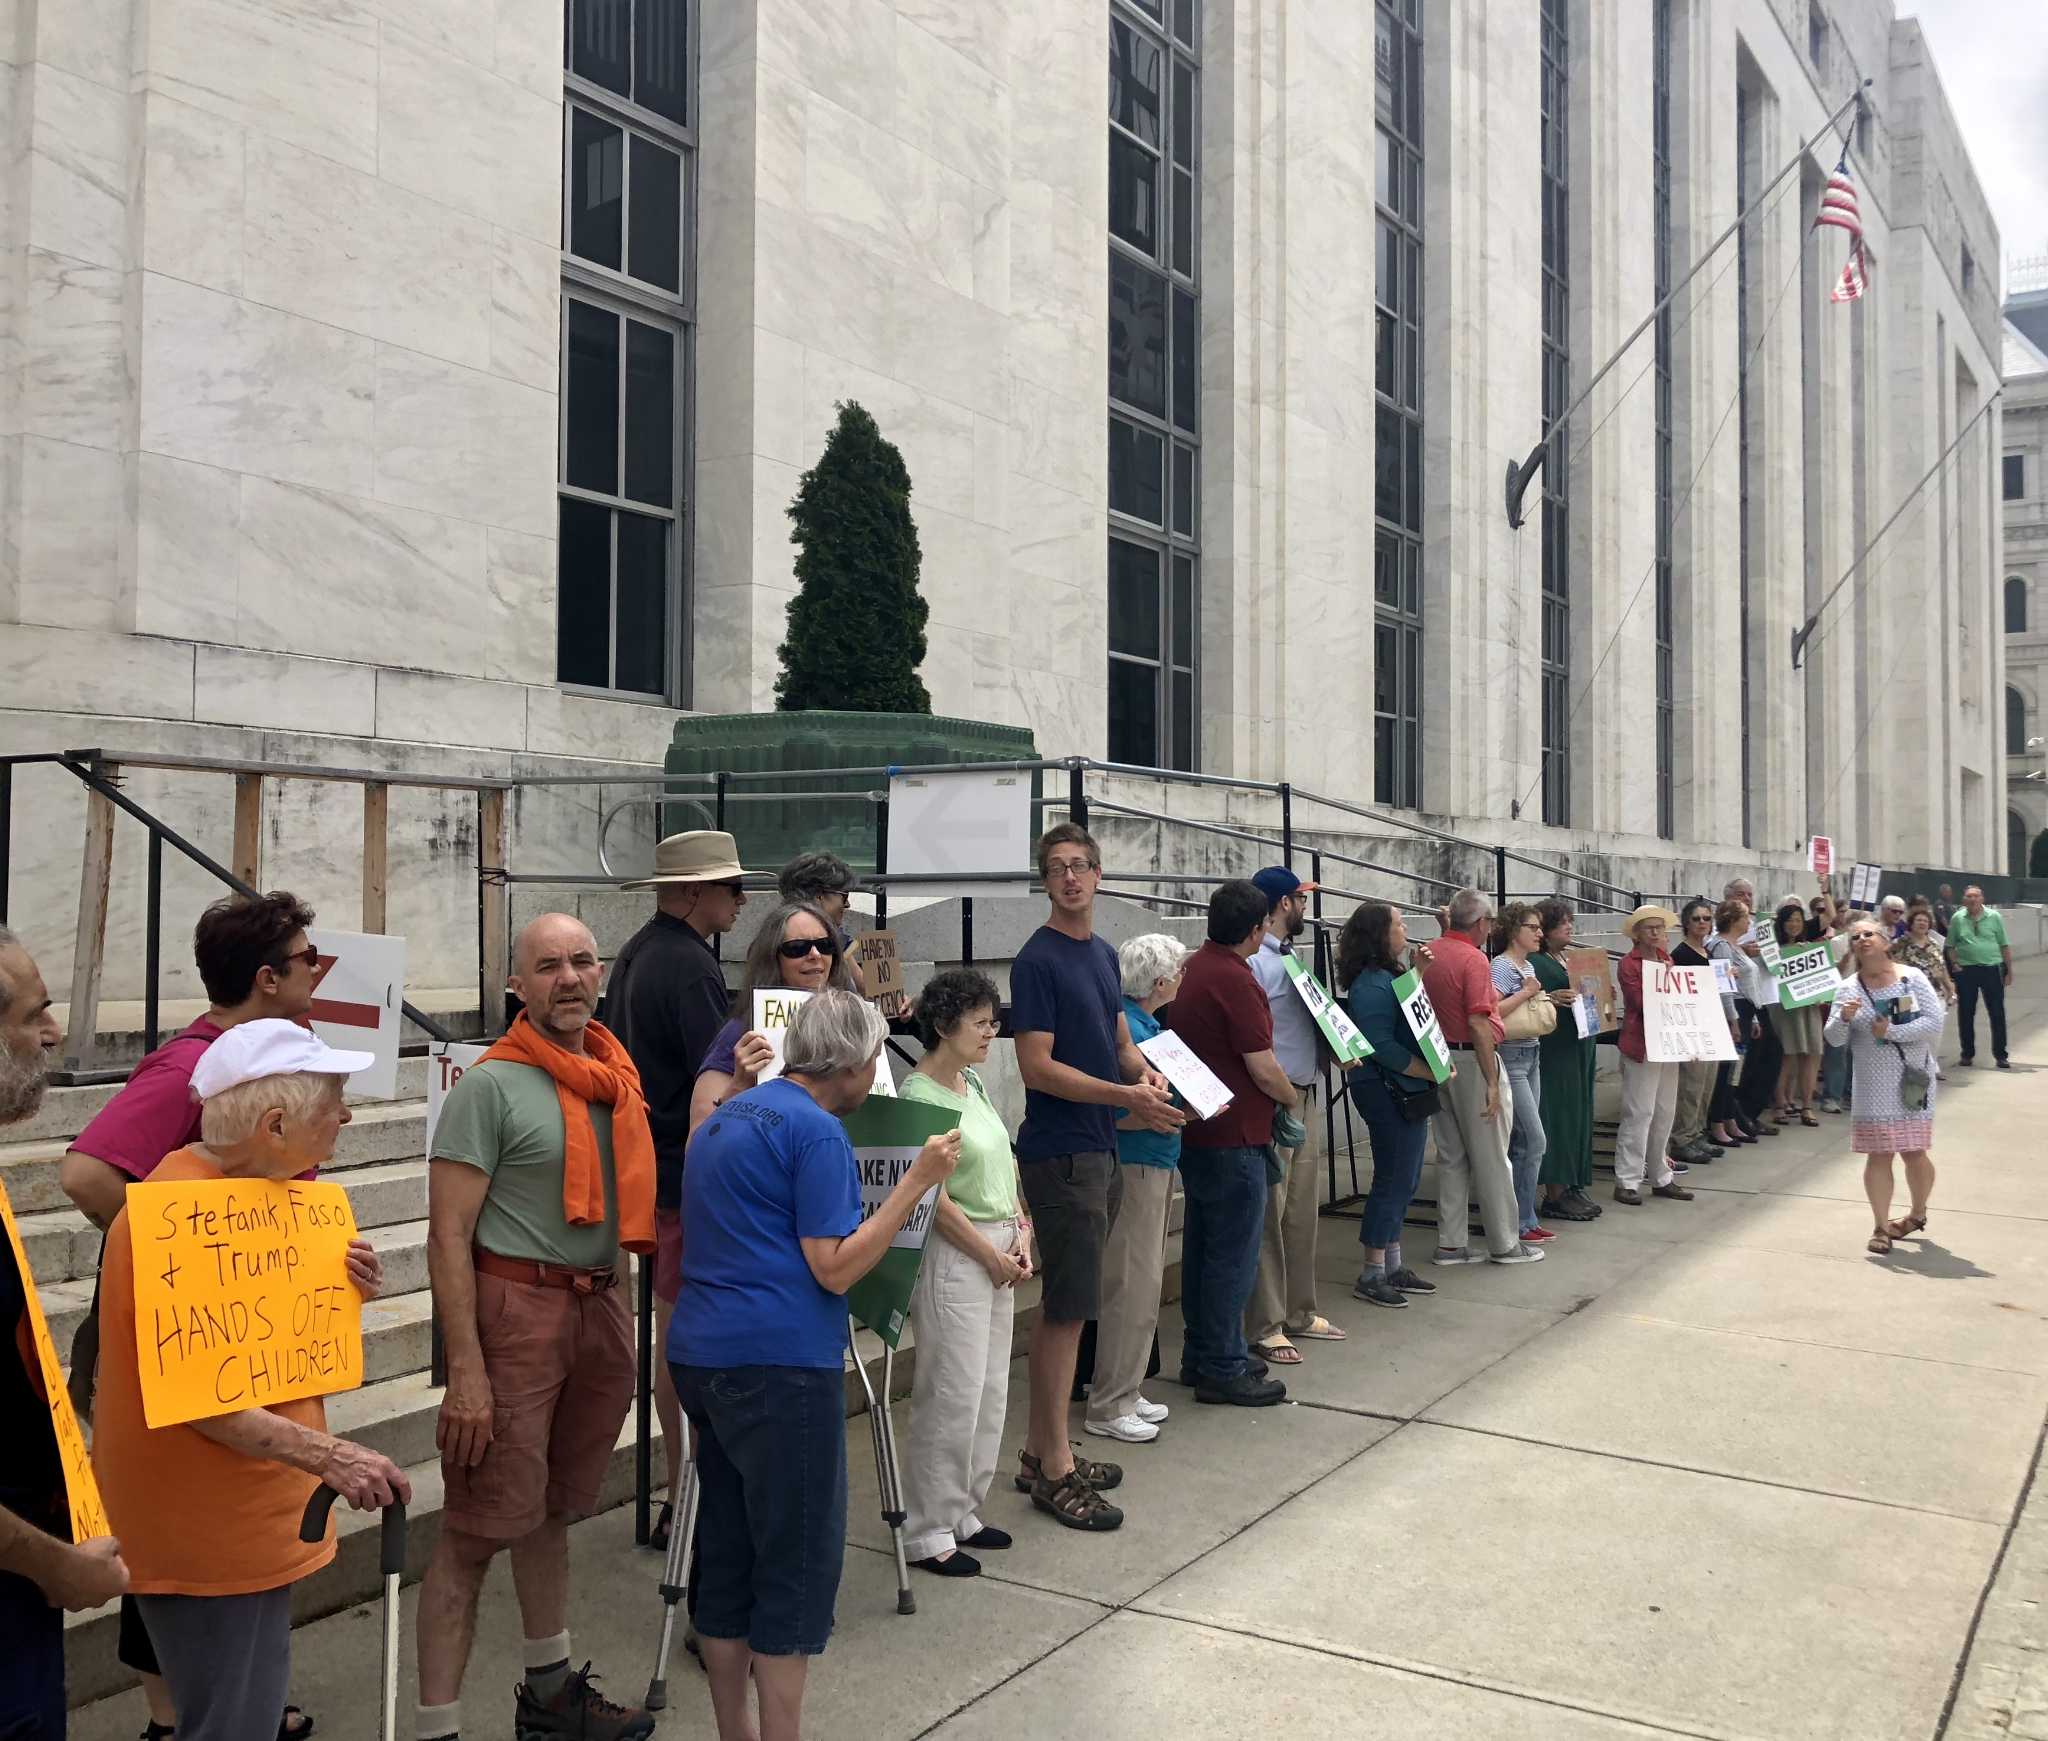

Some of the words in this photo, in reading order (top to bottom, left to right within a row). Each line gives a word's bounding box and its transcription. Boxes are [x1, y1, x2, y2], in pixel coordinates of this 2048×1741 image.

[877, 960, 891, 984] NO
[1655, 968, 1699, 994] LOVE
[763, 999, 803, 1029] FAM
[1411, 987, 1434, 1030] RES
[1660, 1001, 1698, 1027] NOT
[1659, 1031, 1717, 1056] HATE
[855, 1159, 885, 1186] AKE
[288, 1189, 346, 1233] Faso
[203, 1242, 306, 1287] Trump:
[155, 1295, 274, 1377] HANDS
[292, 1286, 345, 1337] OFF
[215, 1333, 349, 1404] CHILDREN
